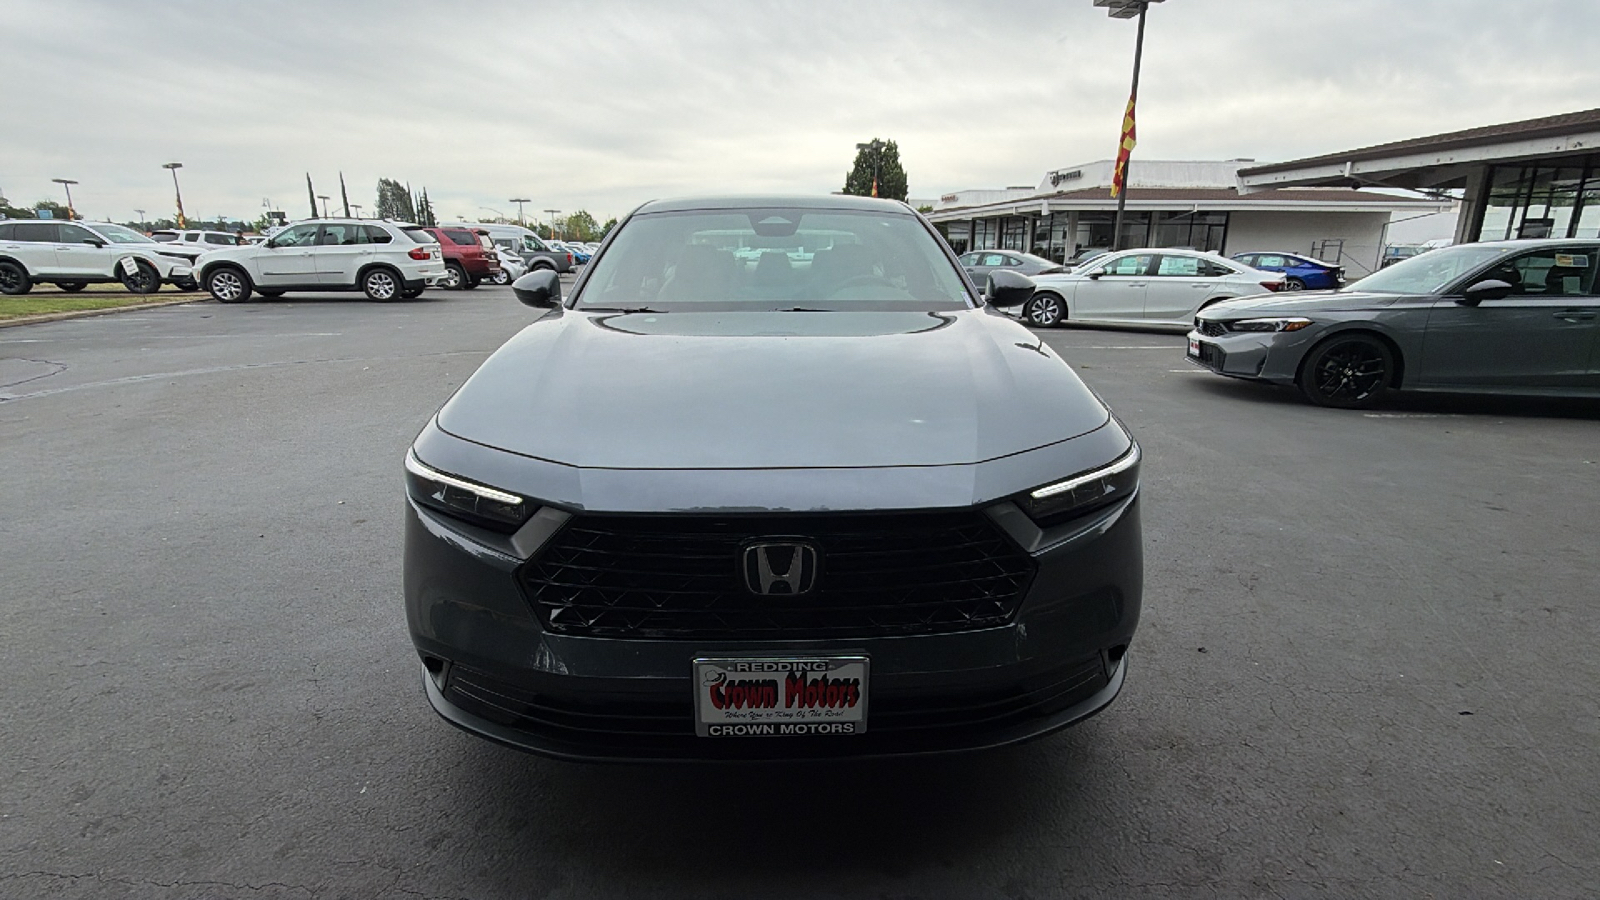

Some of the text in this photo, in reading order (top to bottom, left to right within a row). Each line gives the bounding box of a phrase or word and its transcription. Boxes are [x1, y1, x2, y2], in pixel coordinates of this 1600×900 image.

[736, 662, 827, 672] REDDING
[709, 671, 860, 710] Crown Motors
[724, 711, 747, 719] Where
[775, 711, 794, 719] King
[796, 710, 806, 719] Of
[808, 710, 822, 718] The
[709, 723, 854, 736] CROWN MOTORS
